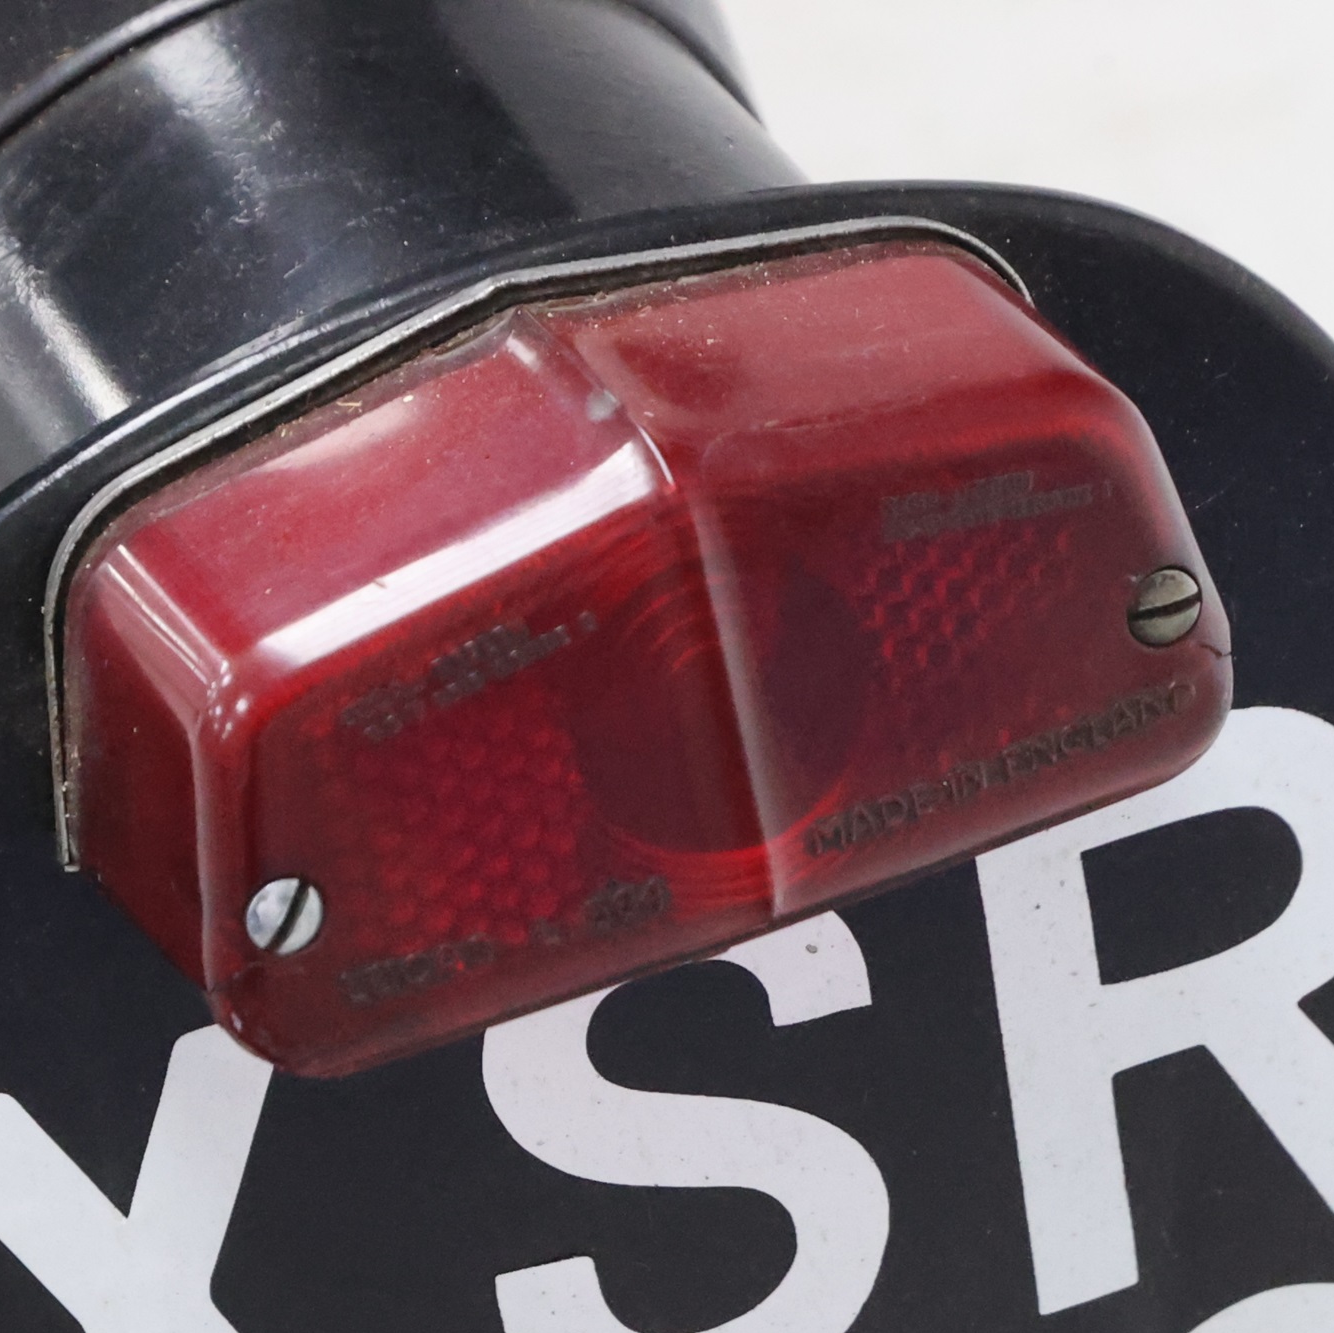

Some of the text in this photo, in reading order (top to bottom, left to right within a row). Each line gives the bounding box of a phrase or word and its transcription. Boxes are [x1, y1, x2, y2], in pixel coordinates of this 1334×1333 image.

[807, 680, 1198, 857] MADE IN ENGLAND
